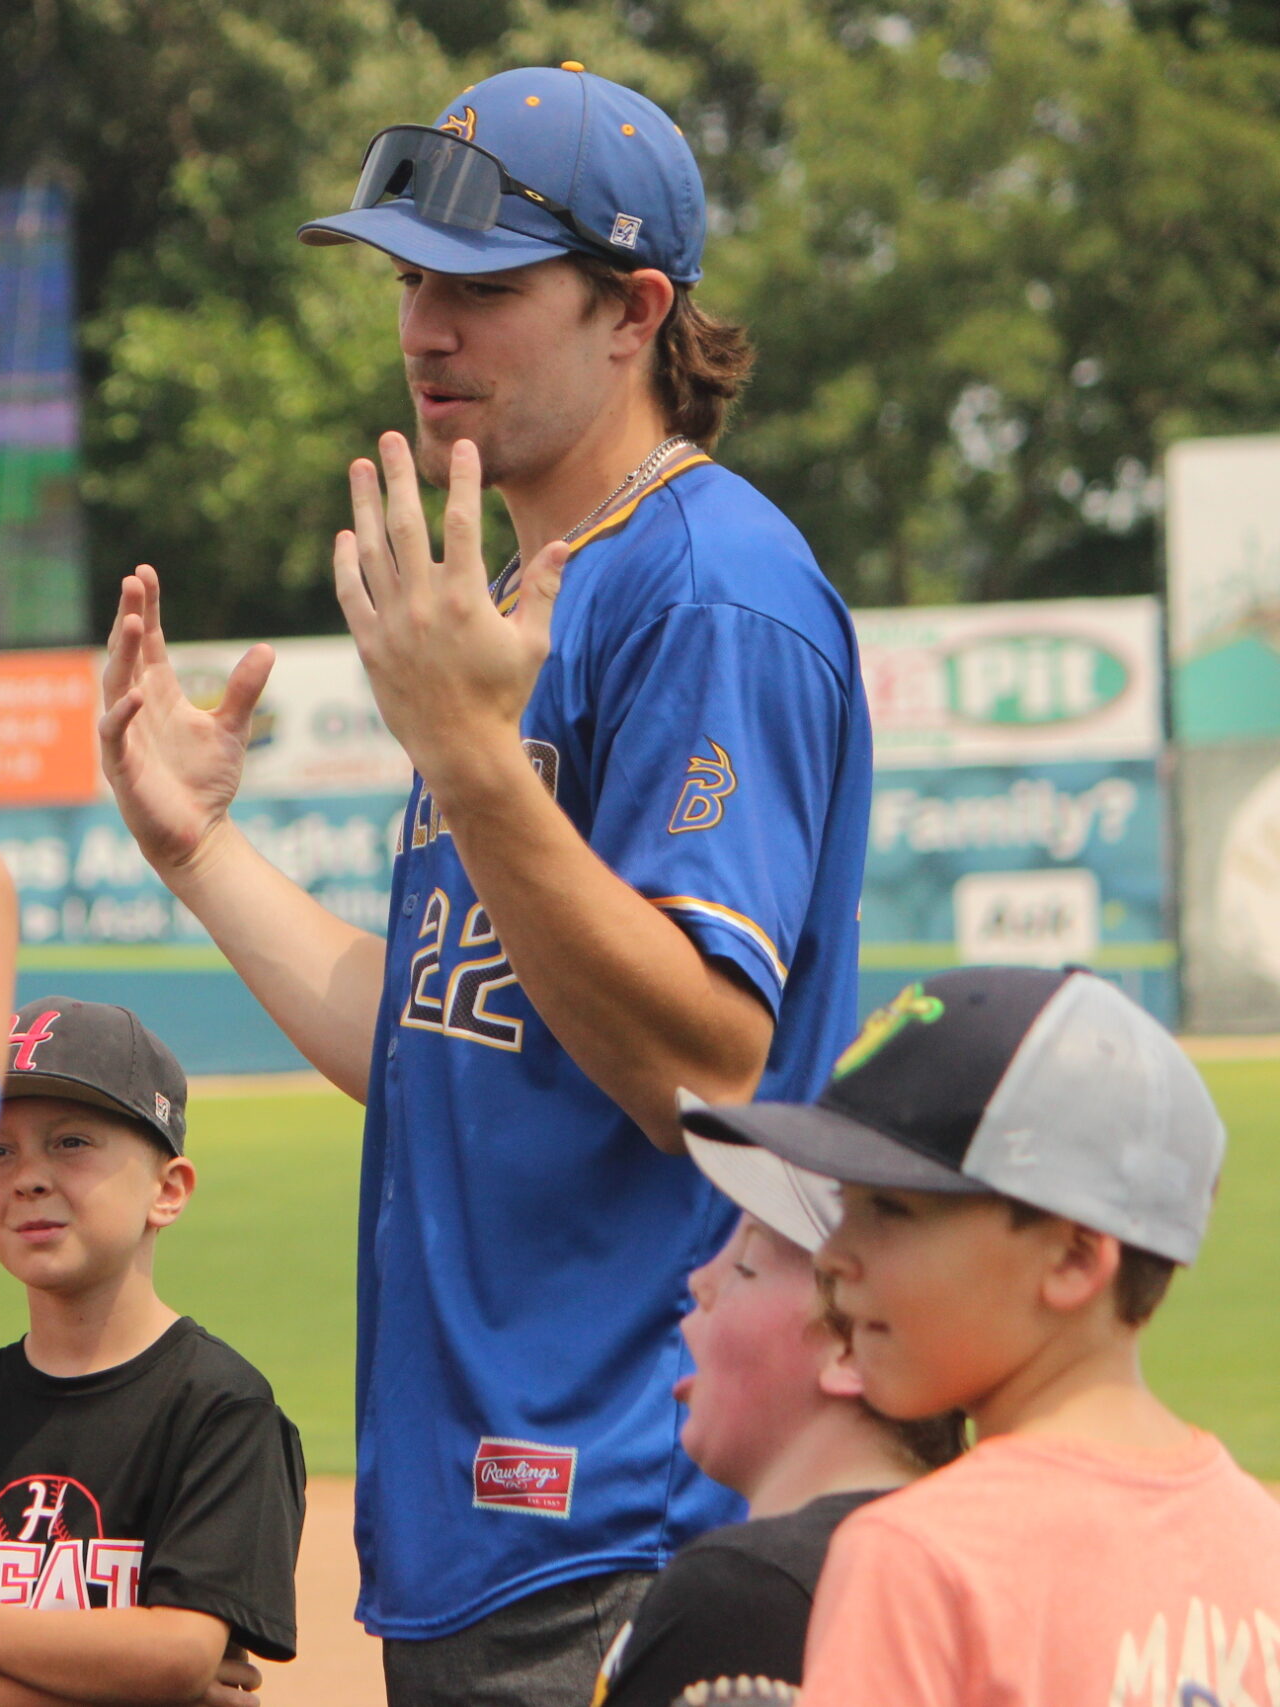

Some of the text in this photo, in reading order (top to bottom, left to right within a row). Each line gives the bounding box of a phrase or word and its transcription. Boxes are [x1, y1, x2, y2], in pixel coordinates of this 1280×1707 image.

[872, 778, 1138, 862] Family?
[400, 886, 524, 1053] 22
[17, 1480, 70, 1541] H
[481, 1461, 560, 1489] Rawlings
